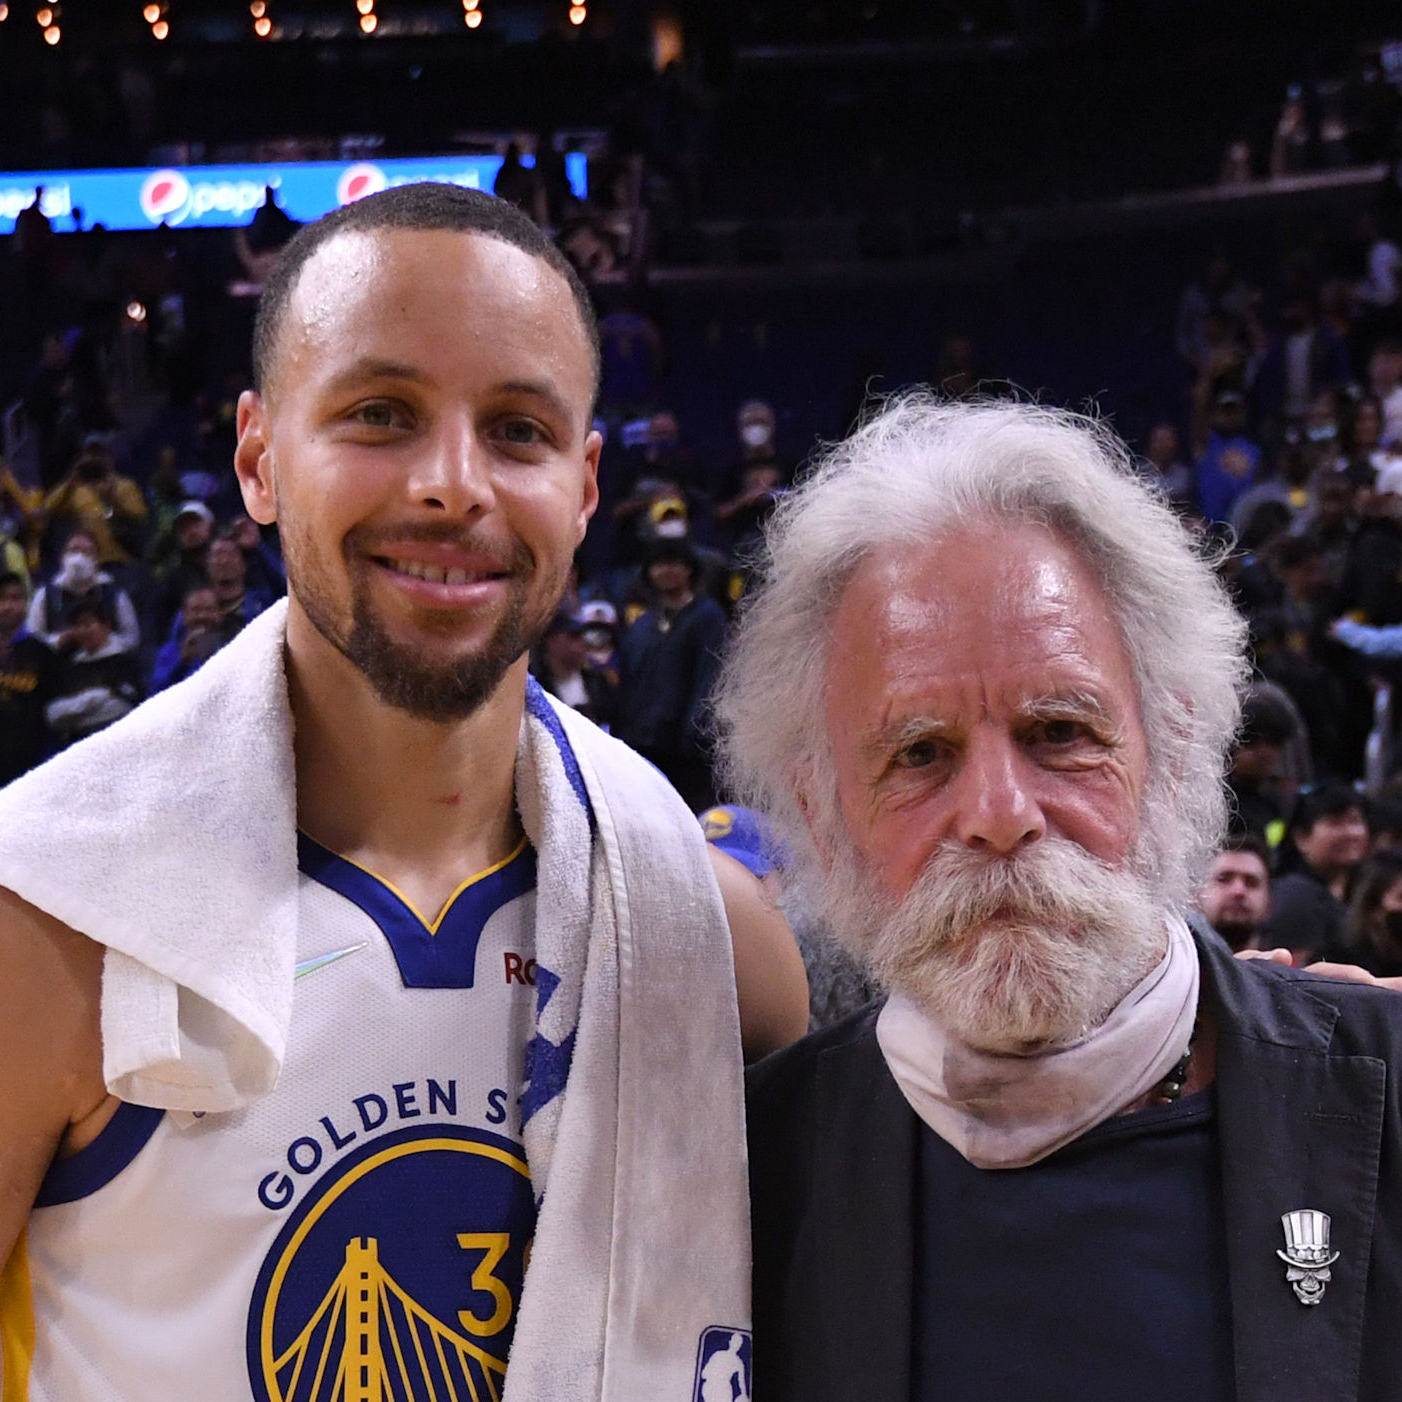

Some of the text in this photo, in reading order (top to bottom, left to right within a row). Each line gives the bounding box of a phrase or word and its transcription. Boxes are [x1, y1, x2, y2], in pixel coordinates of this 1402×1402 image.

[190, 174, 284, 218] pep
[258, 1079, 514, 1210] GOLDEN S
[456, 1232, 528, 1337] 3
